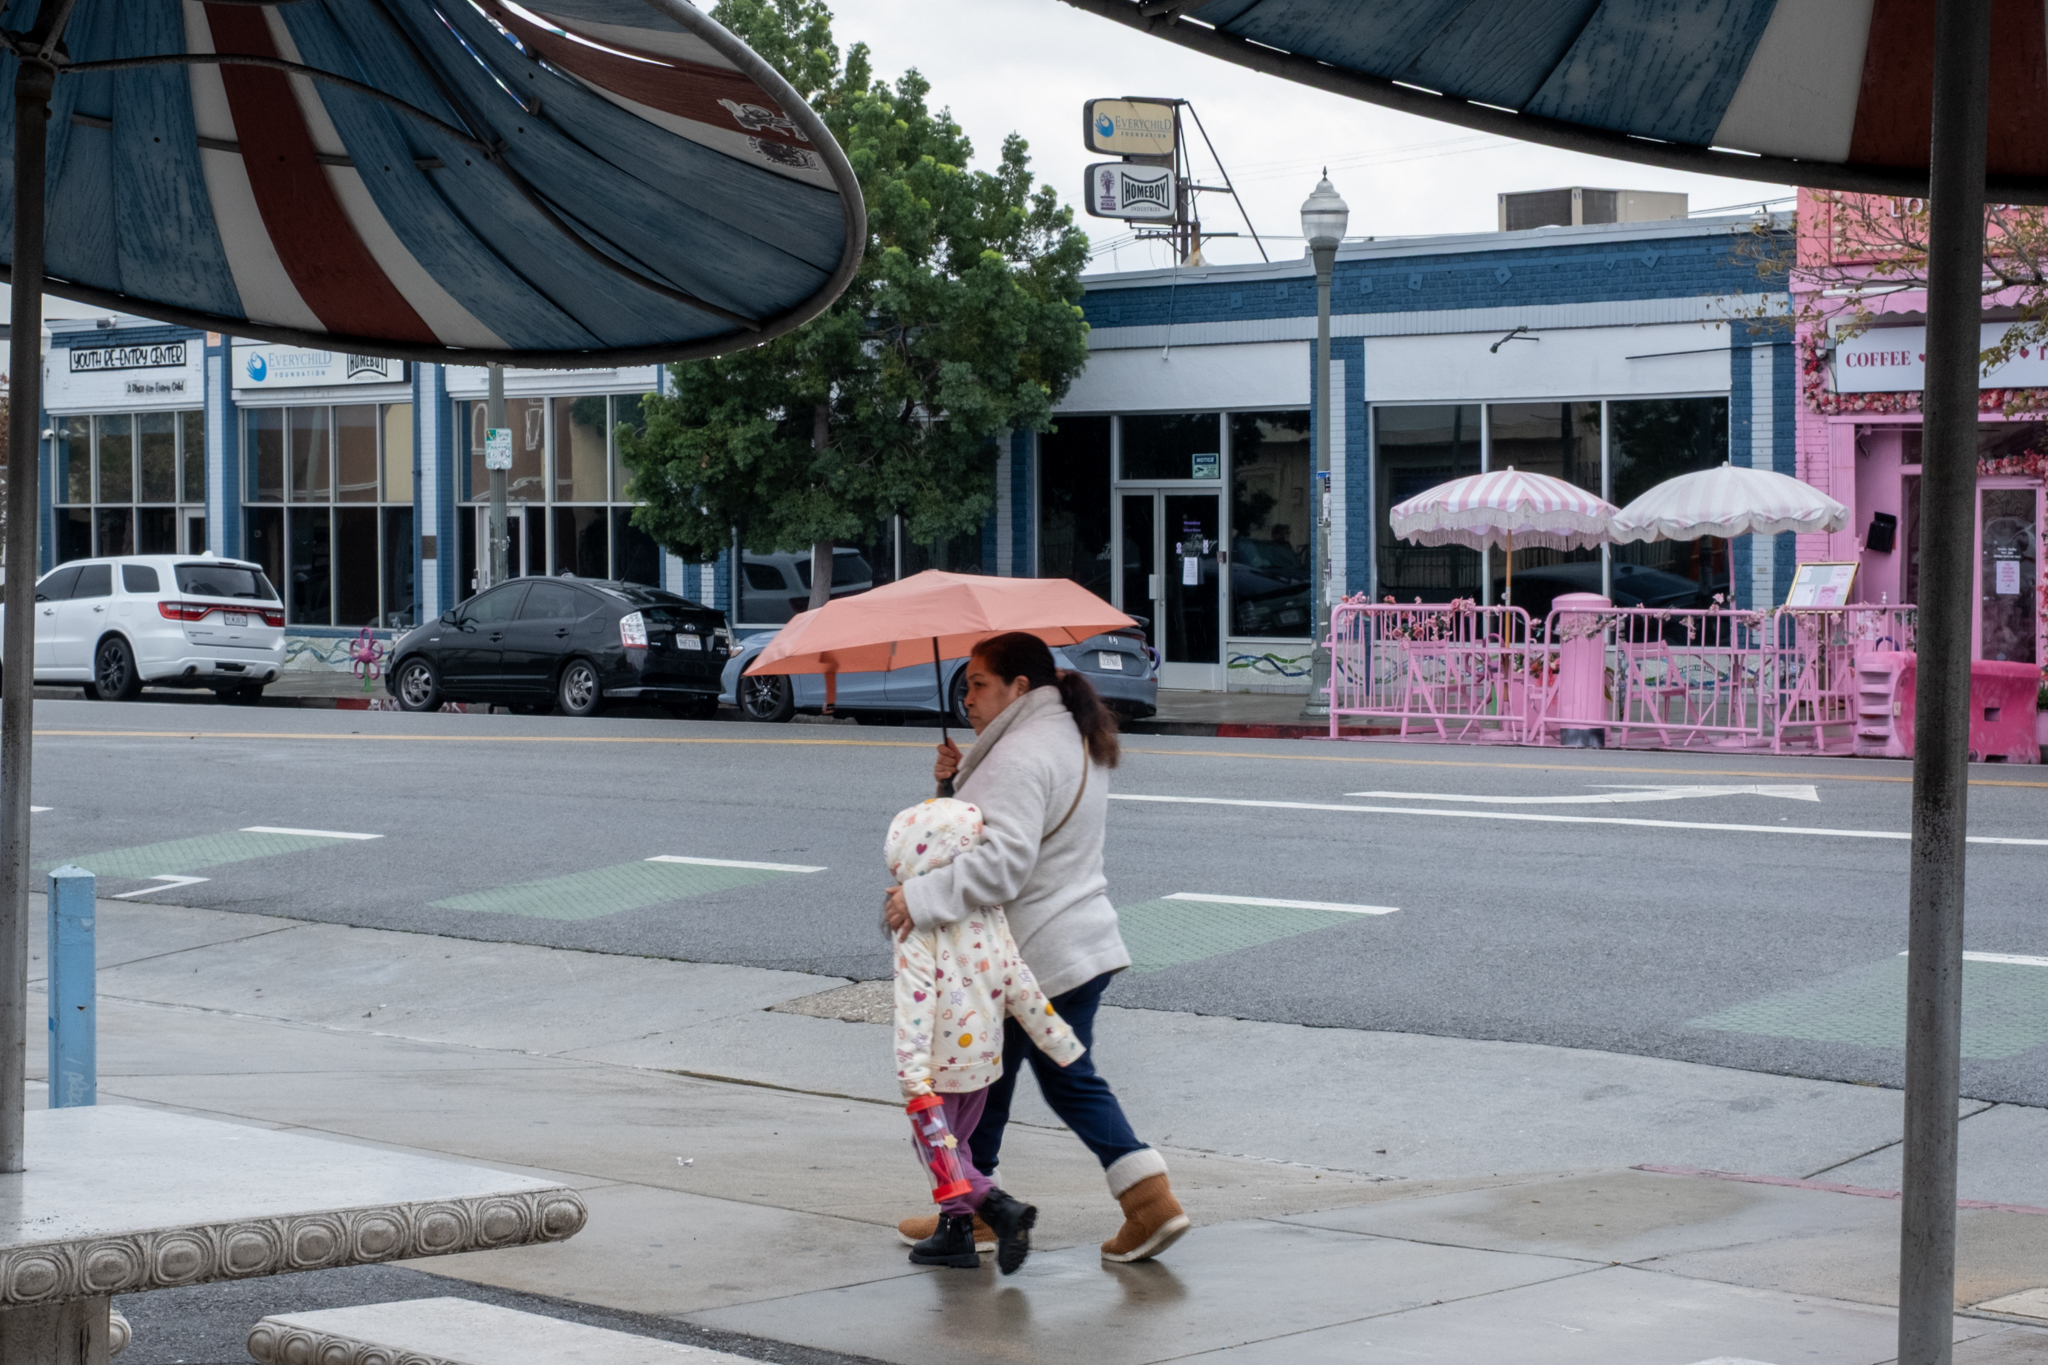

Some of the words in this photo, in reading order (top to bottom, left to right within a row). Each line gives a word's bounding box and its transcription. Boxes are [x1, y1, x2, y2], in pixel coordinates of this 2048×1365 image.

[1115, 116, 1172, 131] EVERYCHILD
[1121, 131, 1167, 139] FOUNDATION
[1124, 181, 1166, 203] HOMEBOY
[73, 351, 102, 369] YOUTH
[104, 348, 148, 367] RE-ENTRY
[150, 345, 183, 364] CENTER
[268, 350, 332, 368] EVERYCHILD
[1845, 351, 1912, 368] COFFEE
[275, 370, 326, 378] FOUNDATION
